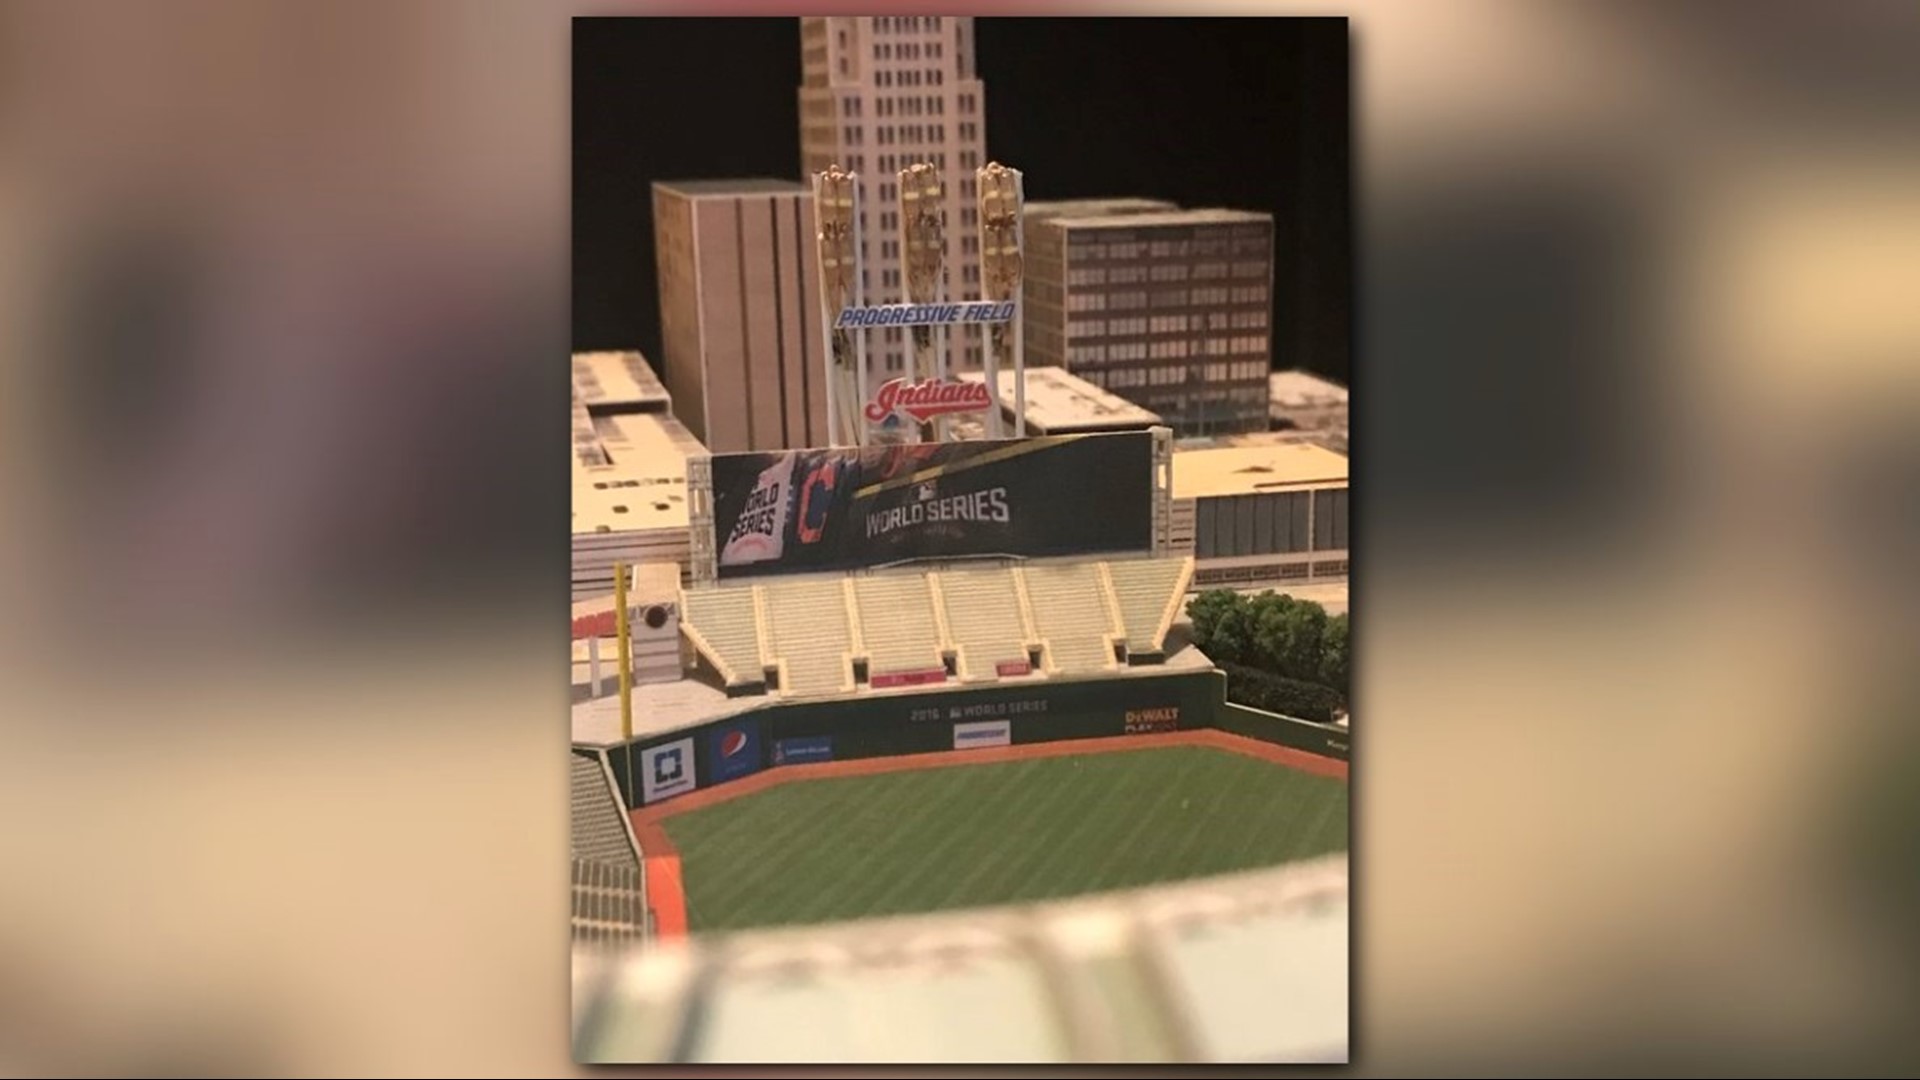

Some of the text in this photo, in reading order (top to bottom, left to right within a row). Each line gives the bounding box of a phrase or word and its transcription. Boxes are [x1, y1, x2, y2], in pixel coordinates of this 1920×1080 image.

[838, 303, 1015, 326] PROGRESSIVE FIELD
[865, 377, 992, 423] Indians
[744, 483, 779, 515] ORLD
[866, 504, 924, 539] WORLD
[927, 487, 1010, 523] SERIES
[731, 508, 776, 543] SERIES
[964, 704, 1006, 717] WORLD
[1009, 700, 1048, 713] SERIES
